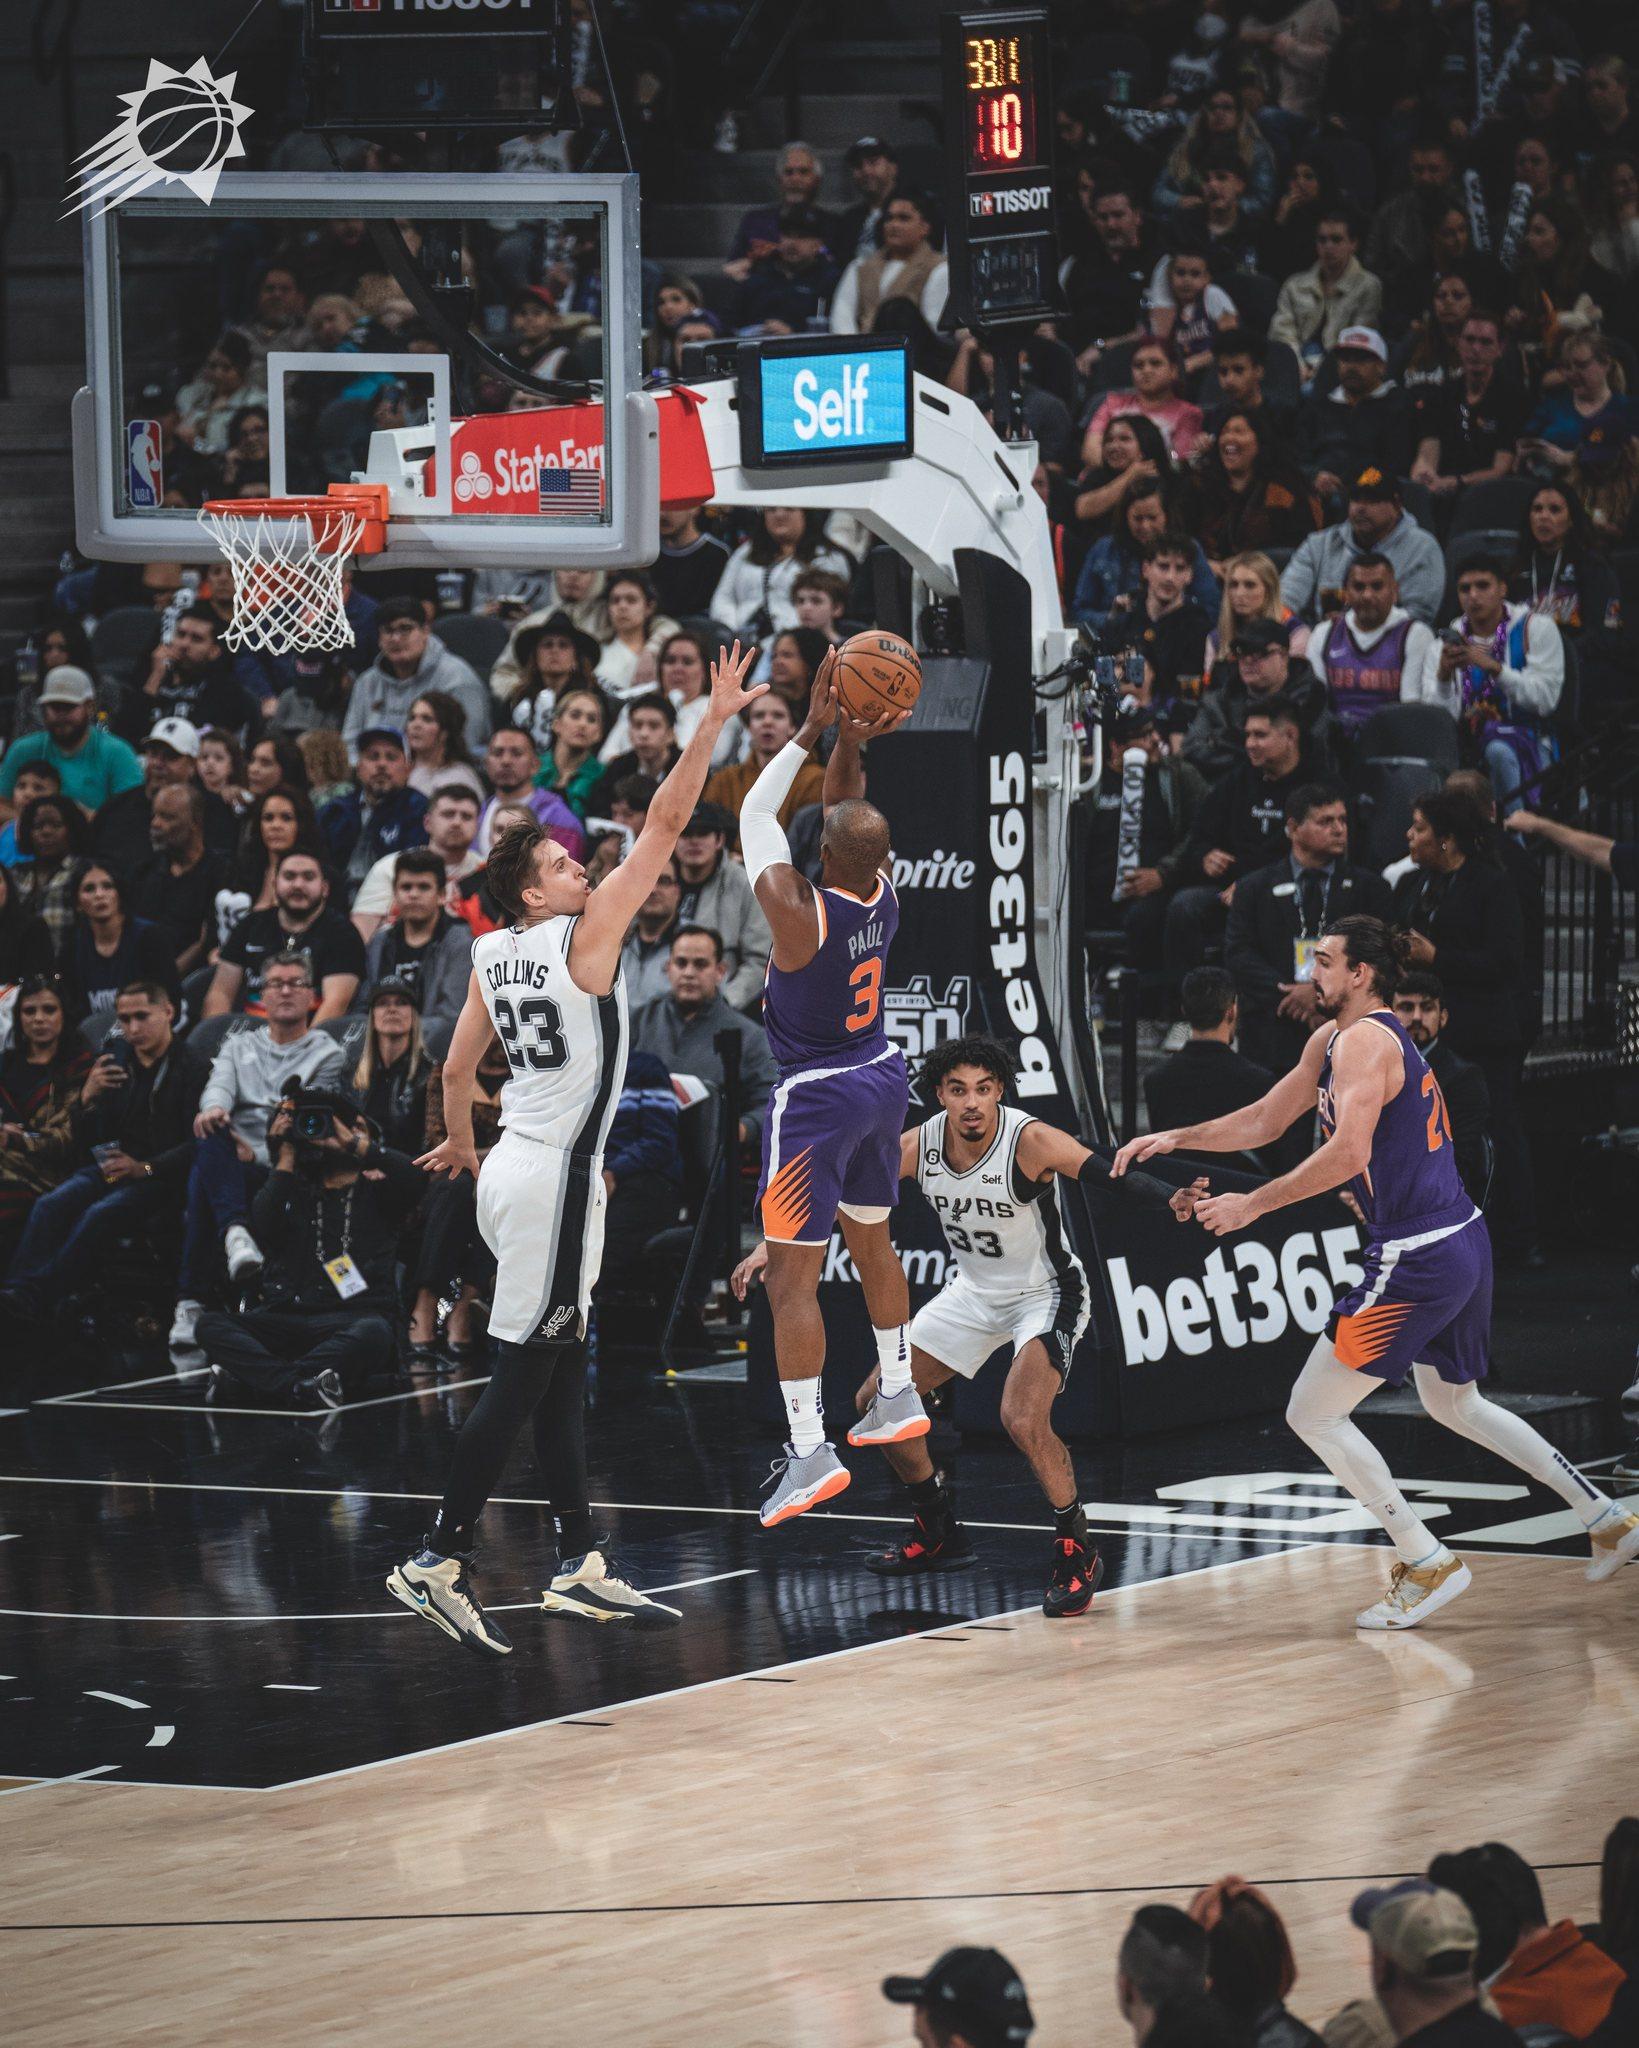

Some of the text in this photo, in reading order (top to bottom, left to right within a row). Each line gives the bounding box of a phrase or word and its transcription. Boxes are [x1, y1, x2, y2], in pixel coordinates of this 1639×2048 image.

[993, 186, 1051, 213] TISSOT
[560, 438, 605, 480] Far
[888, 849, 976, 890] prite
[848, 921, 884, 960] PAUL
[989, 751, 1058, 1098] bet365
[486, 959, 549, 991] COLLINS
[846, 956, 882, 1033] 3
[494, 996, 571, 1072] 23
[927, 1150, 938, 1164] 6
[945, 1223, 1005, 1259] 33
[1107, 1225, 1366, 1366] bet365
